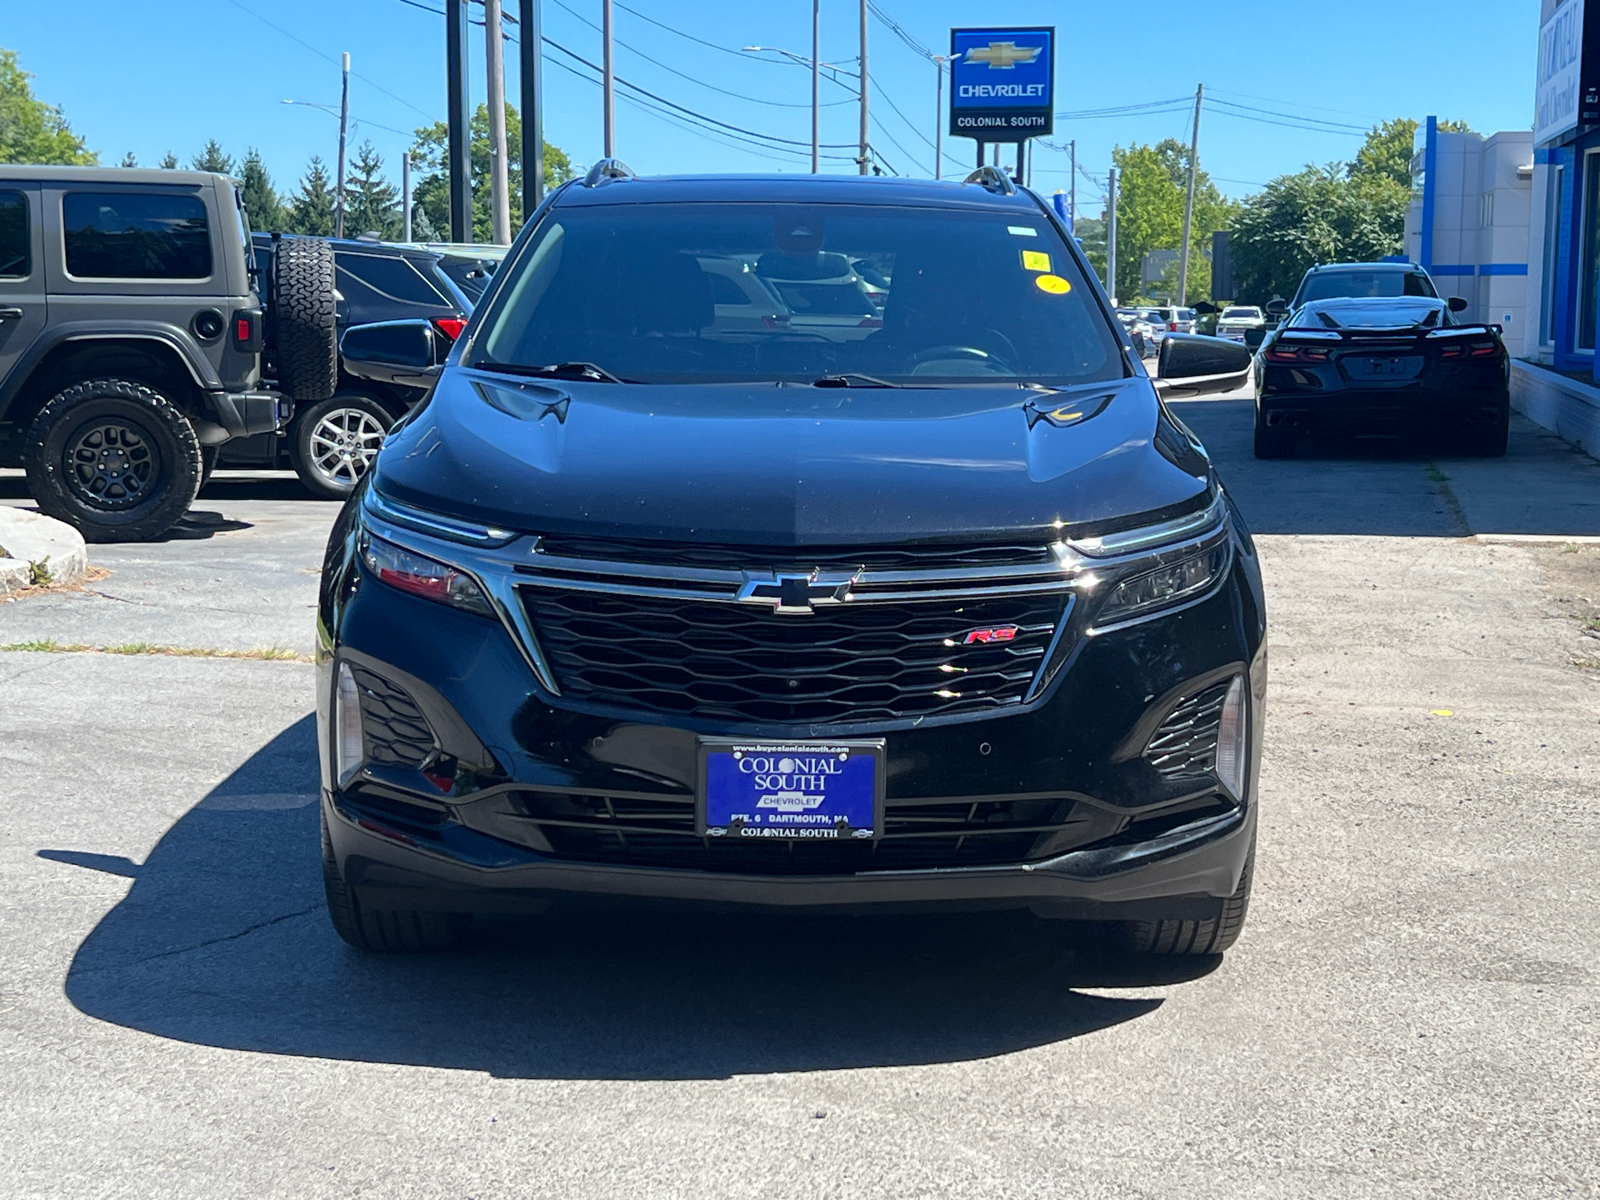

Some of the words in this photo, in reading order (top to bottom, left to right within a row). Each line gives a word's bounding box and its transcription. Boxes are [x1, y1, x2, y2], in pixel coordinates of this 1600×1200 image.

[959, 84, 1045, 98] CHEVROLET
[958, 117, 1007, 127] COLONIAL
[1011, 117, 1045, 127] SOUTH
[963, 626, 1018, 644] RS
[733, 745, 850, 753] www.buycolonialsouth.com
[738, 757, 842, 774] COLONIAL
[754, 774, 826, 790] SOUTH
[754, 814, 761, 823] 6
[768, 814, 832, 824] DARTMOUTH,
[741, 828, 798, 838] COLONIAL
[799, 828, 838, 838] SOUTH
